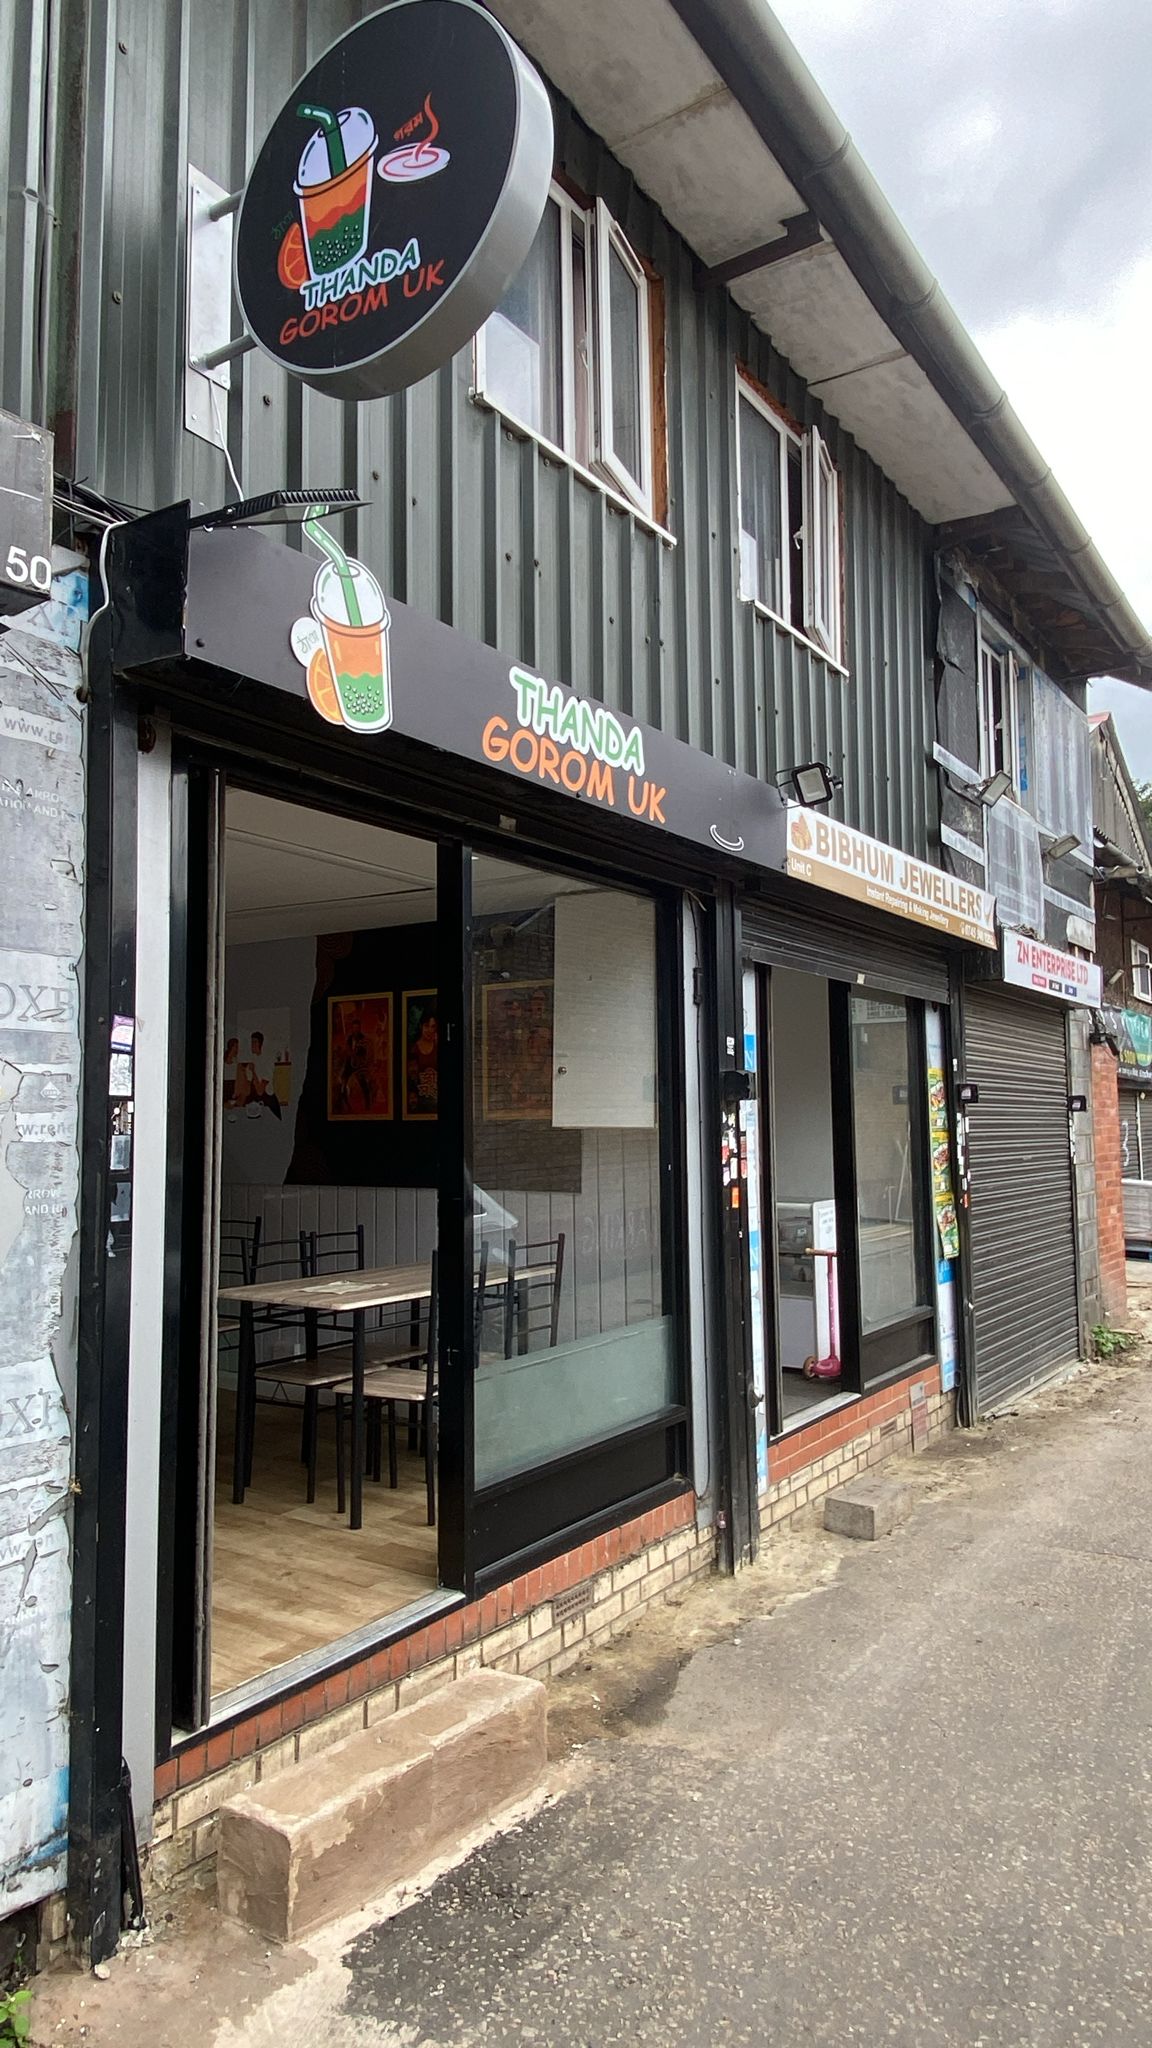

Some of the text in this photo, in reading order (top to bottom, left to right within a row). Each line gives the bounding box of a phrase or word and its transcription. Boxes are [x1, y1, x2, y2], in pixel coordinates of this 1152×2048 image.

[279, 260, 445, 345] GOROM UK
[301, 238, 420, 311] THANDA
[6, 545, 52, 590] 50
[509, 666, 645, 776] THANDA
[482, 716, 666, 824] GOROM UK
[791, 857, 812, 877] Unit C
[816, 820, 894, 885] BIBHUM
[900, 860, 982, 921] JEWELLERS
[1017, 940, 1089, 985] ZN ENTERPRISE LTD
[25, 1204, 49, 1215] AND
